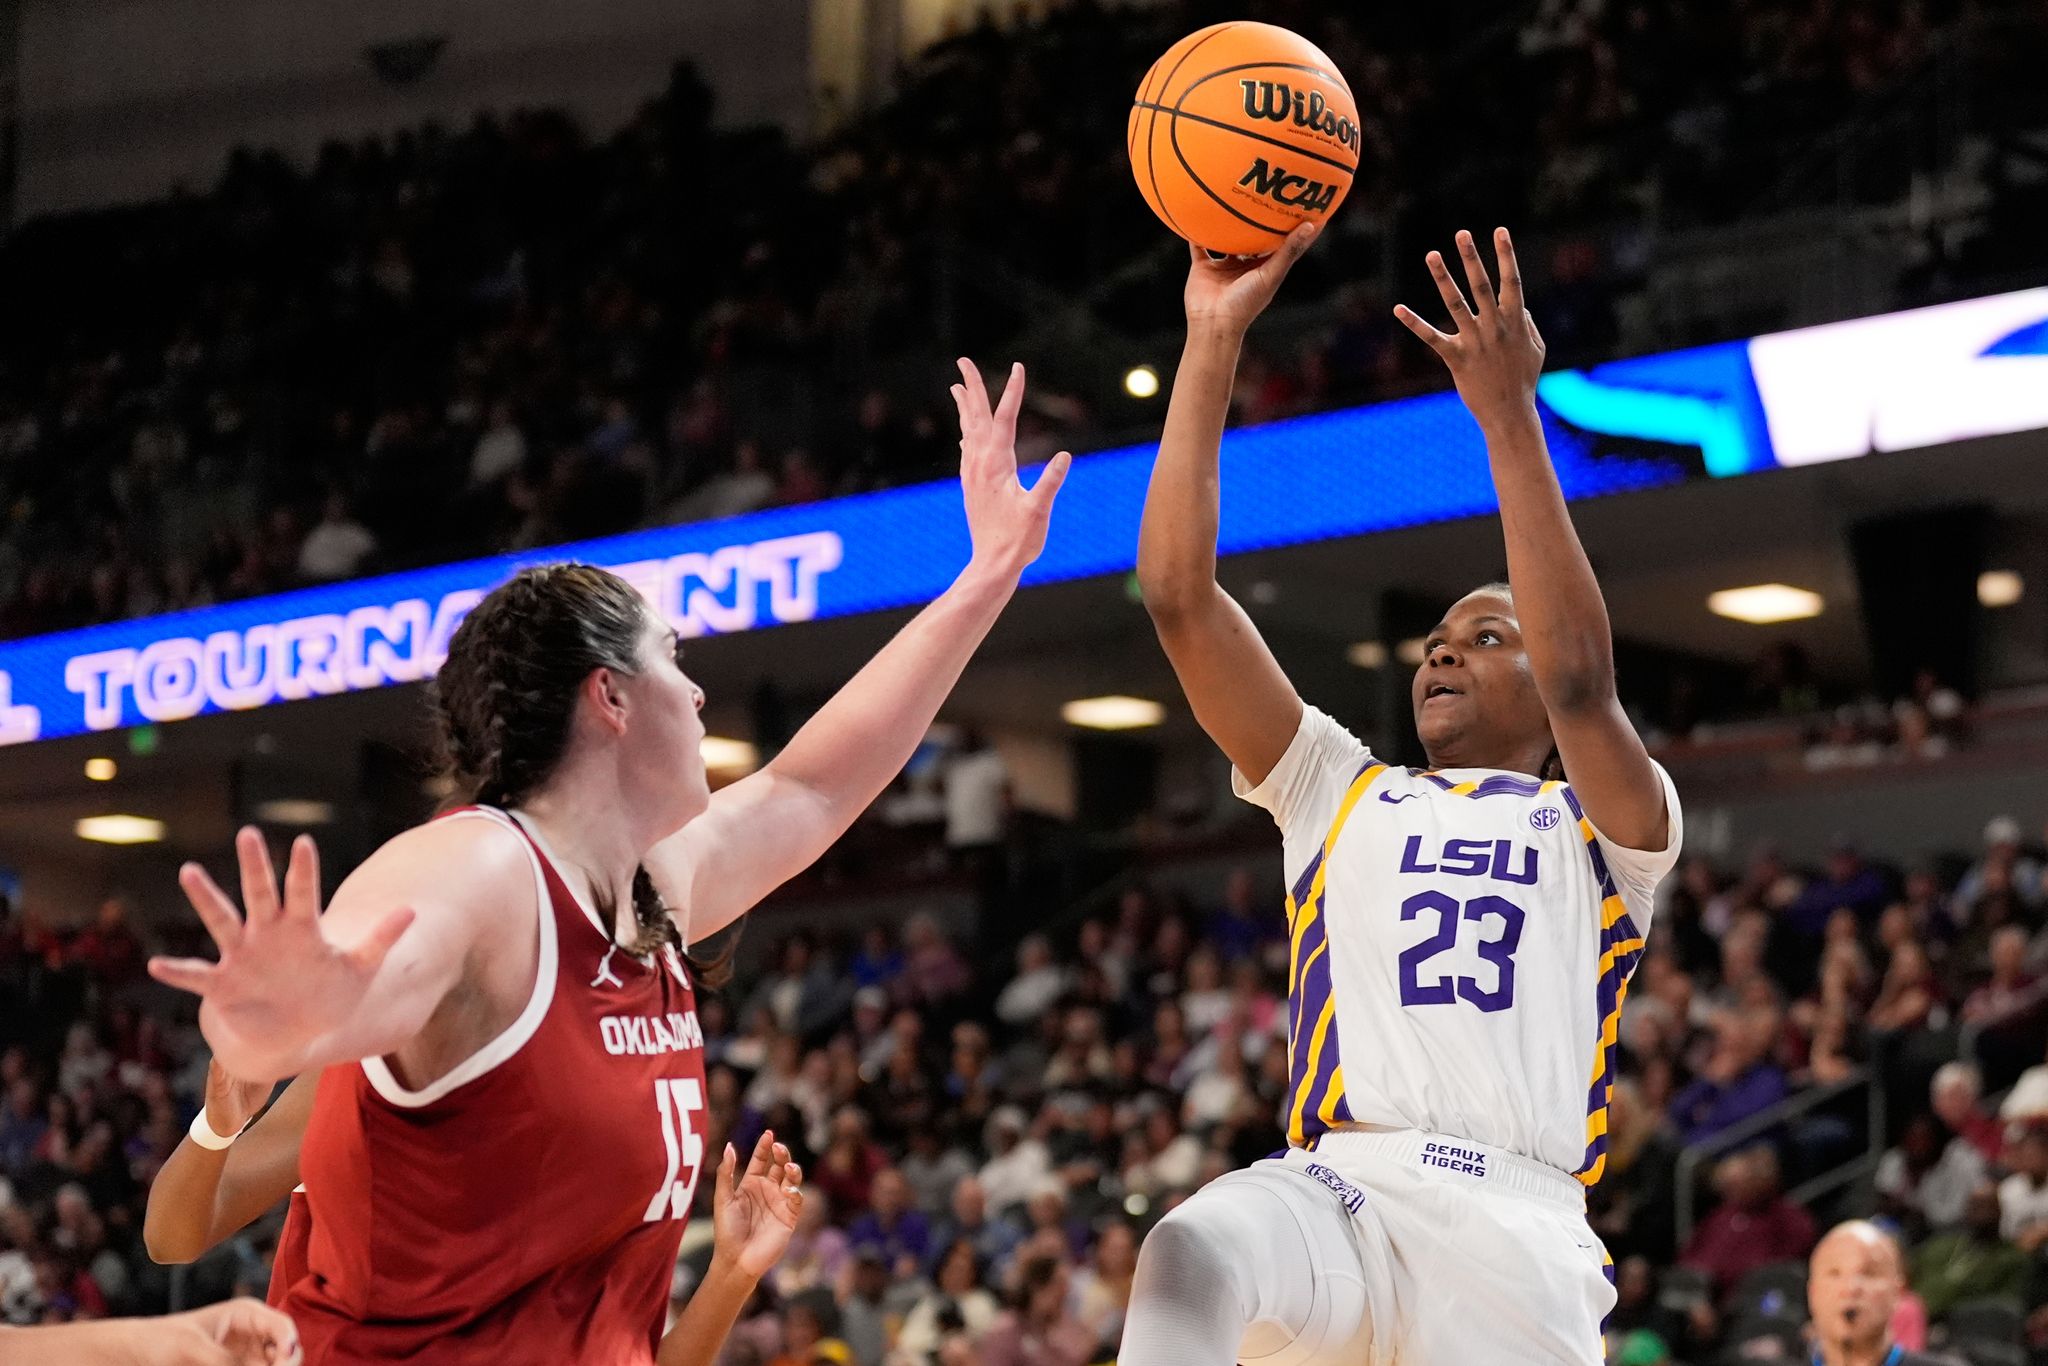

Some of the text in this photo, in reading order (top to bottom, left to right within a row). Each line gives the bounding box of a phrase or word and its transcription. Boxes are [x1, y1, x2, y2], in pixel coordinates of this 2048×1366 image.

[1240, 79, 1359, 159] Wilson
[1238, 157, 1338, 213] NCAA
[65, 531, 844, 731] TOURNNT
[1531, 807, 1559, 829] SEC
[1399, 835, 1538, 885] LSU
[1399, 890, 1525, 1012] 23
[599, 1011, 704, 1055] OKLAOMA
[643, 1078, 703, 1221] 15
[1421, 1153, 1486, 1177] TIGERS
[1425, 1143, 1486, 1164] GEAUX
